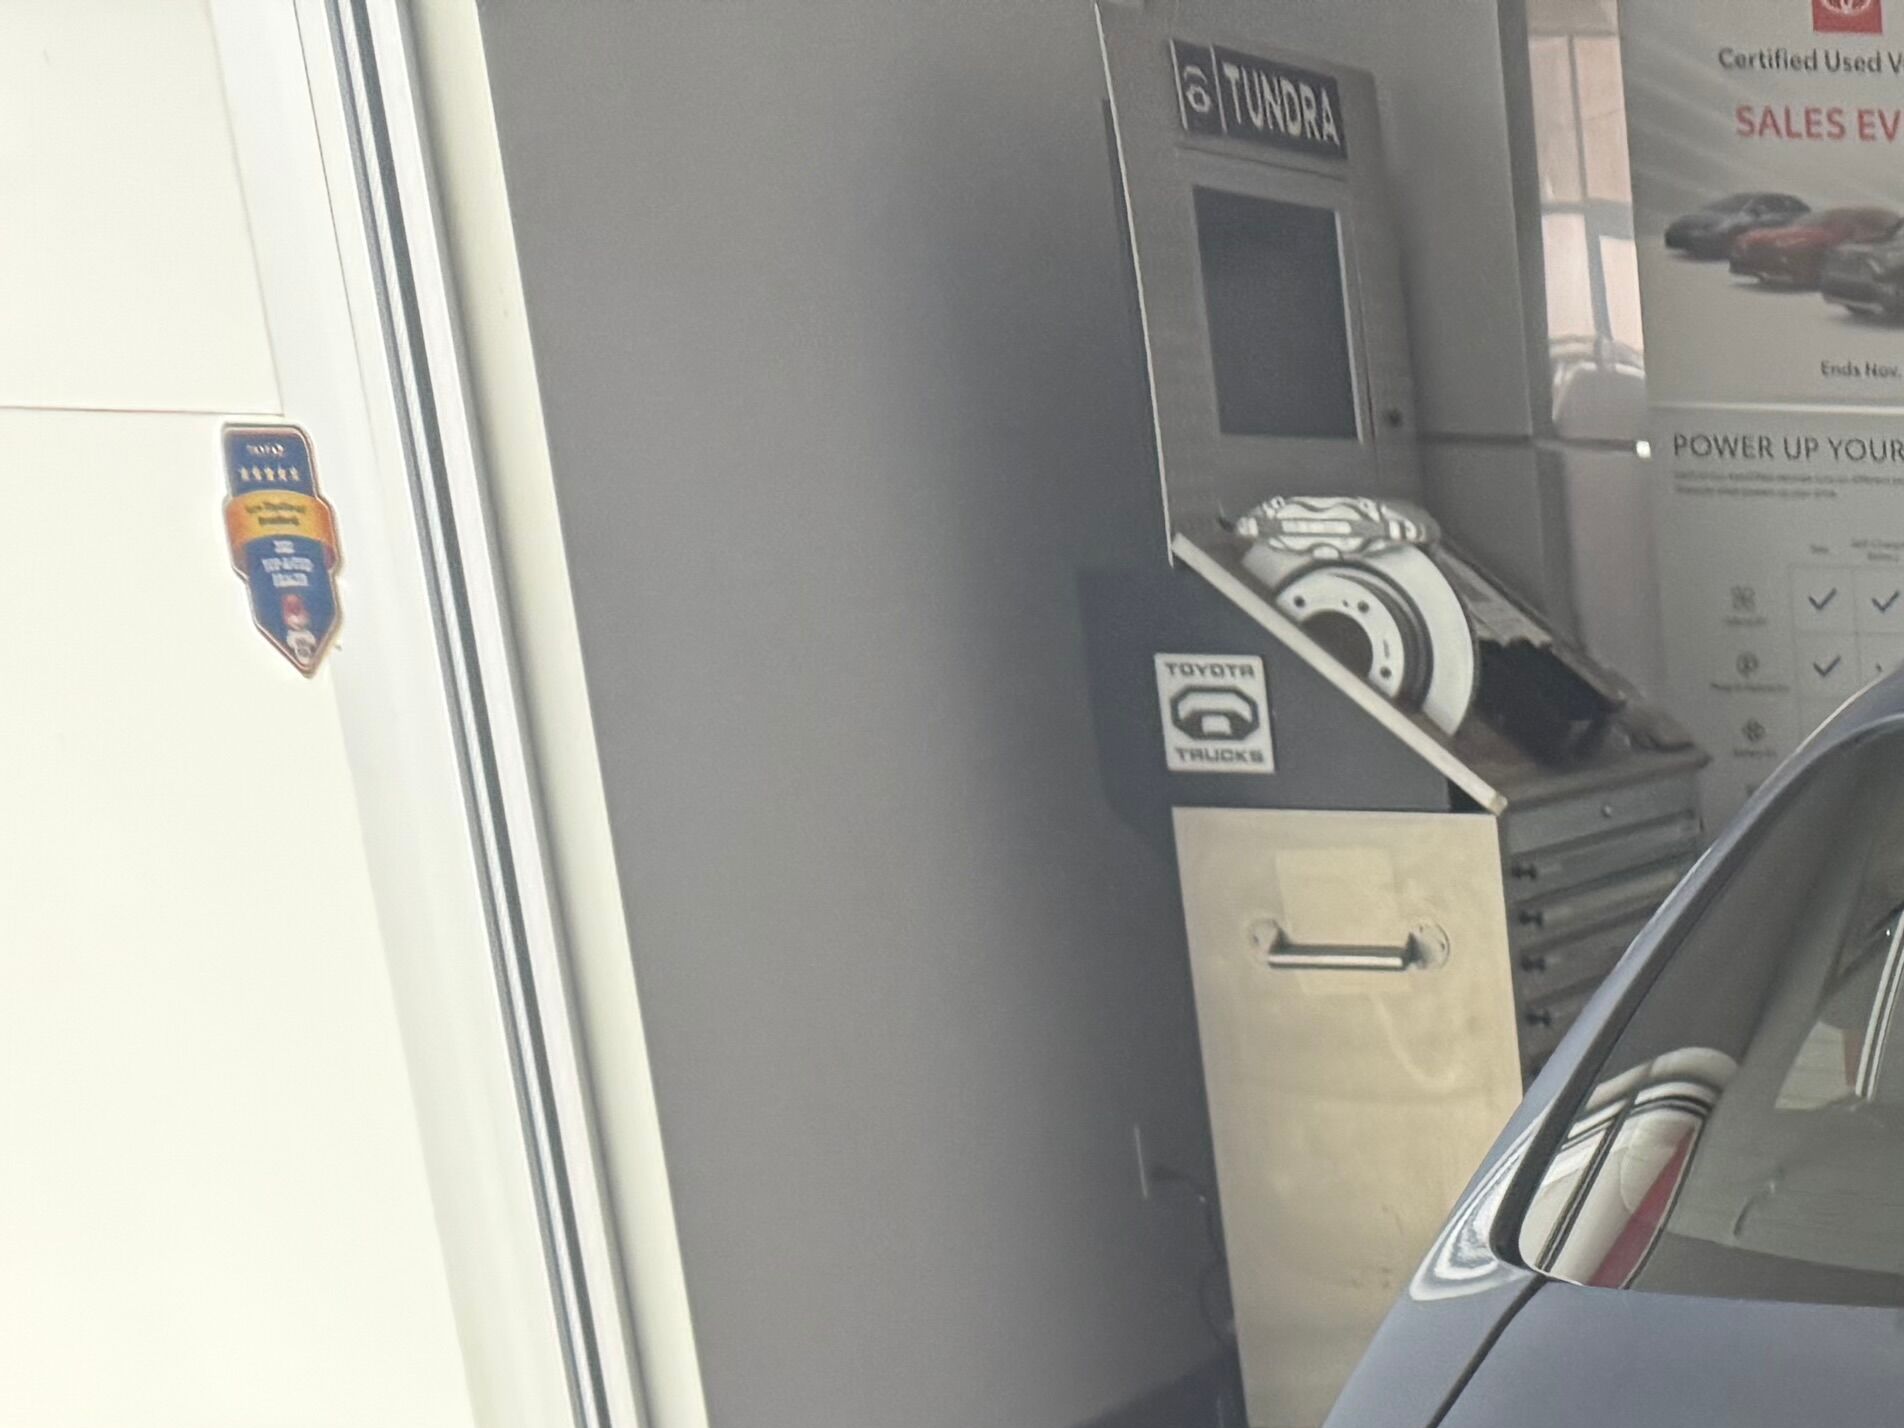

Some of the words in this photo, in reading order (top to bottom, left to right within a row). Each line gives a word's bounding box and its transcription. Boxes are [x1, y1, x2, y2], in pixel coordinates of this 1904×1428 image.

[1718, 47, 1817, 71] Certified
[1824, 50, 1882, 73] Used
[1222, 60, 1341, 147] TUNDRA
[1736, 104, 1847, 140] SALES
[1820, 360, 1861, 378] Ends
[1674, 432, 1775, 460] POWER
[1783, 436, 1819, 461] UP
[1164, 662, 1256, 679] TOYOTA
[1174, 747, 1264, 763] TRUCKS
